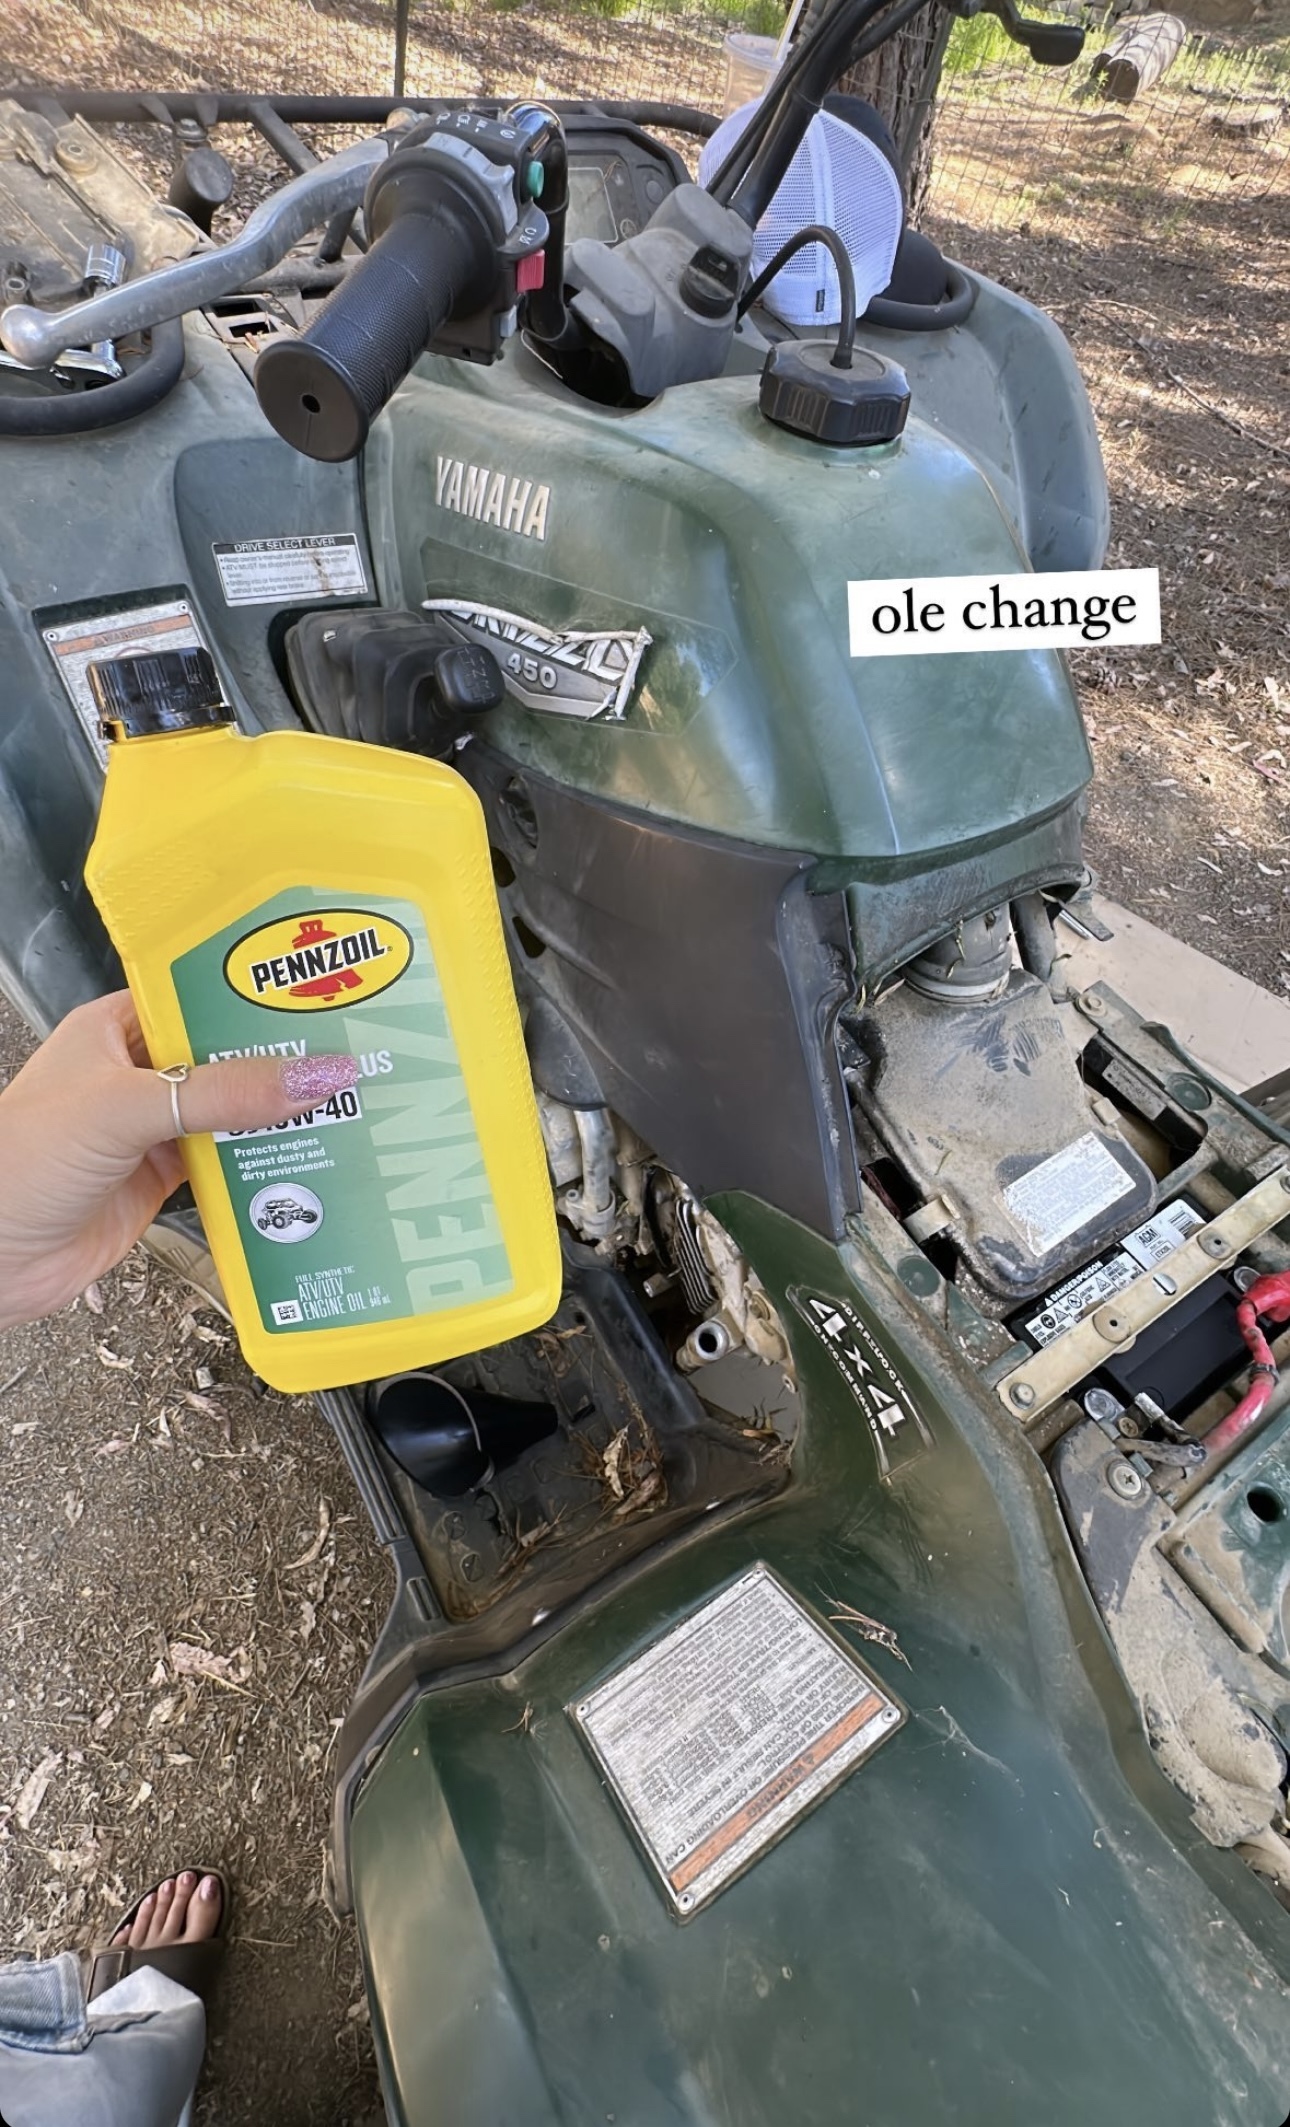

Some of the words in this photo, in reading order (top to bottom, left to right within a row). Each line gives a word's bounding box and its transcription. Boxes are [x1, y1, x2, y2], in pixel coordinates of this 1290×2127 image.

[435, 455, 550, 541] YAMAHA
[233, 542, 265, 553] DRIVE
[265, 539, 303, 550] SELECT
[303, 537, 336, 547] LEVER
[506, 652, 557, 690] 450
[251, 928, 385, 993] PENNZOIL
[234, 1144, 278, 1158] Protects
[279, 1137, 319, 1151] engines
[238, 1156, 275, 1170] against
[278, 1151, 305, 1165] dusty
[307, 1147, 326, 1158] and
[242, 1169, 266, 1181] dirty
[268, 1158, 335, 1178] environments
[1136, 1225, 1158, 1246] AGM
[294, 1271, 314, 1284] FULL
[313, 1263, 356, 1281] SYNTHETIC
[296, 1274, 346, 1303] ATV/UTV
[302, 1293, 347, 1321] ENGINE
[345, 1289, 367, 1312] OIL
